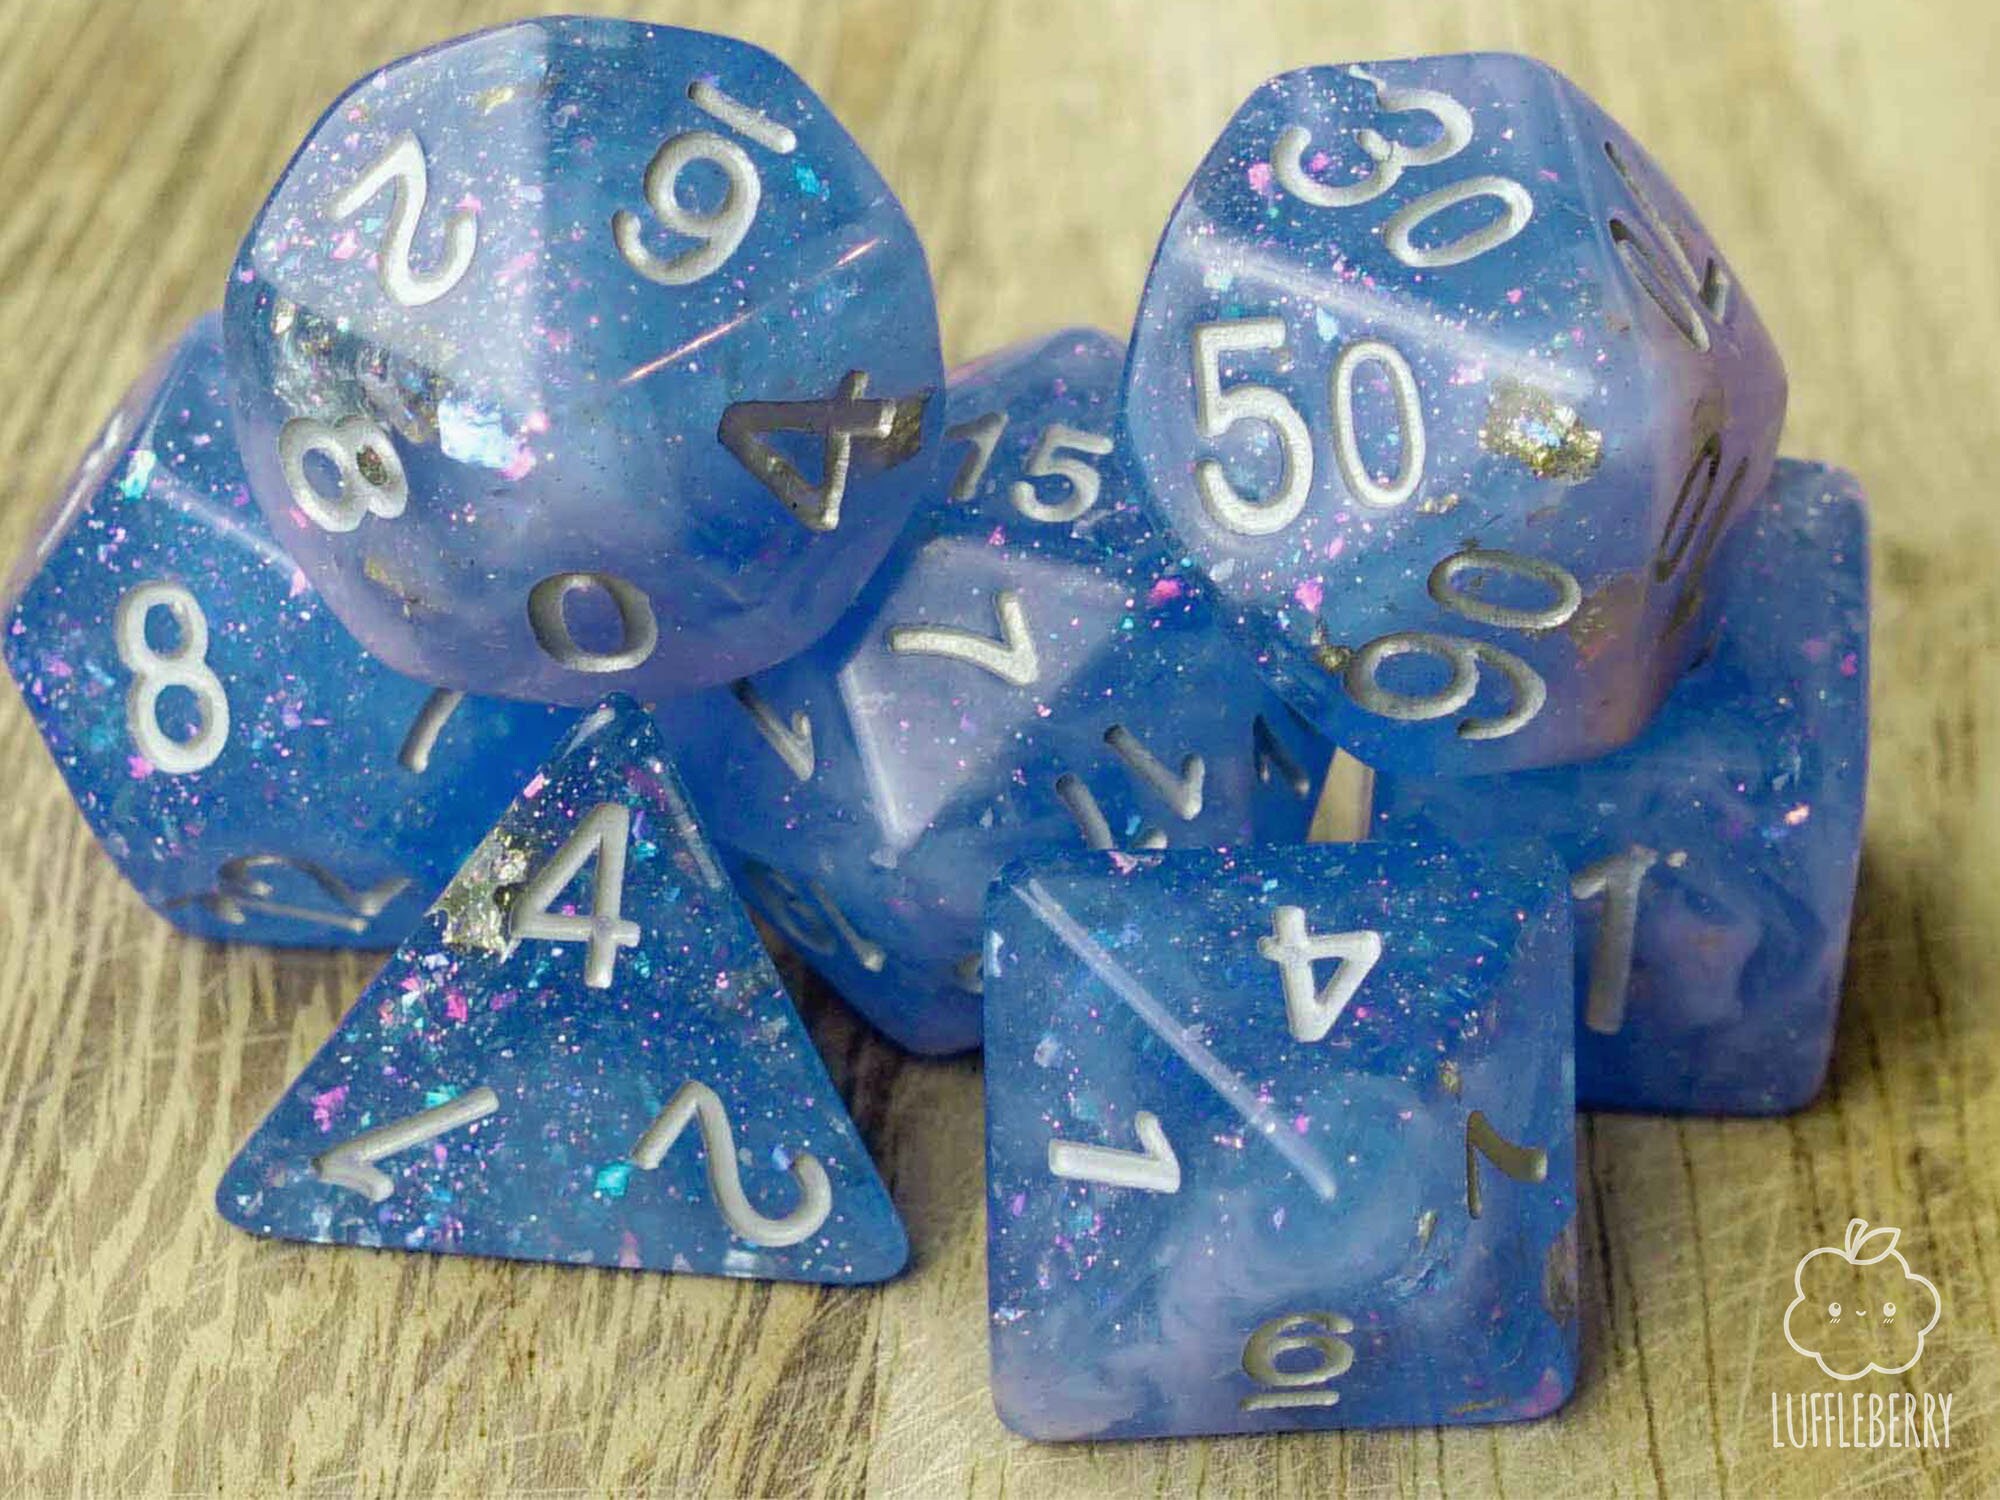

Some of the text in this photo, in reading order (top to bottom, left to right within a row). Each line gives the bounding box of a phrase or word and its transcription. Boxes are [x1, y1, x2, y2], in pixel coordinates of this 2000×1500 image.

[330, 128, 478, 306] 2
[1270, 80, 1534, 268] 30
[279, 416, 408, 533] 8
[717, 369, 898, 531] 4
[946, 411, 1114, 523] 15
[1192, 317, 1425, 536] 50
[117, 580, 230, 774] 8
[528, 572, 659, 673] 0
[510, 801, 641, 990] 4
[1257, 905, 1382, 1043] 4
[313, 1085, 500, 1202] 1
[631, 1080, 833, 1248] 2
[1240, 1311, 1356, 1410] 6
